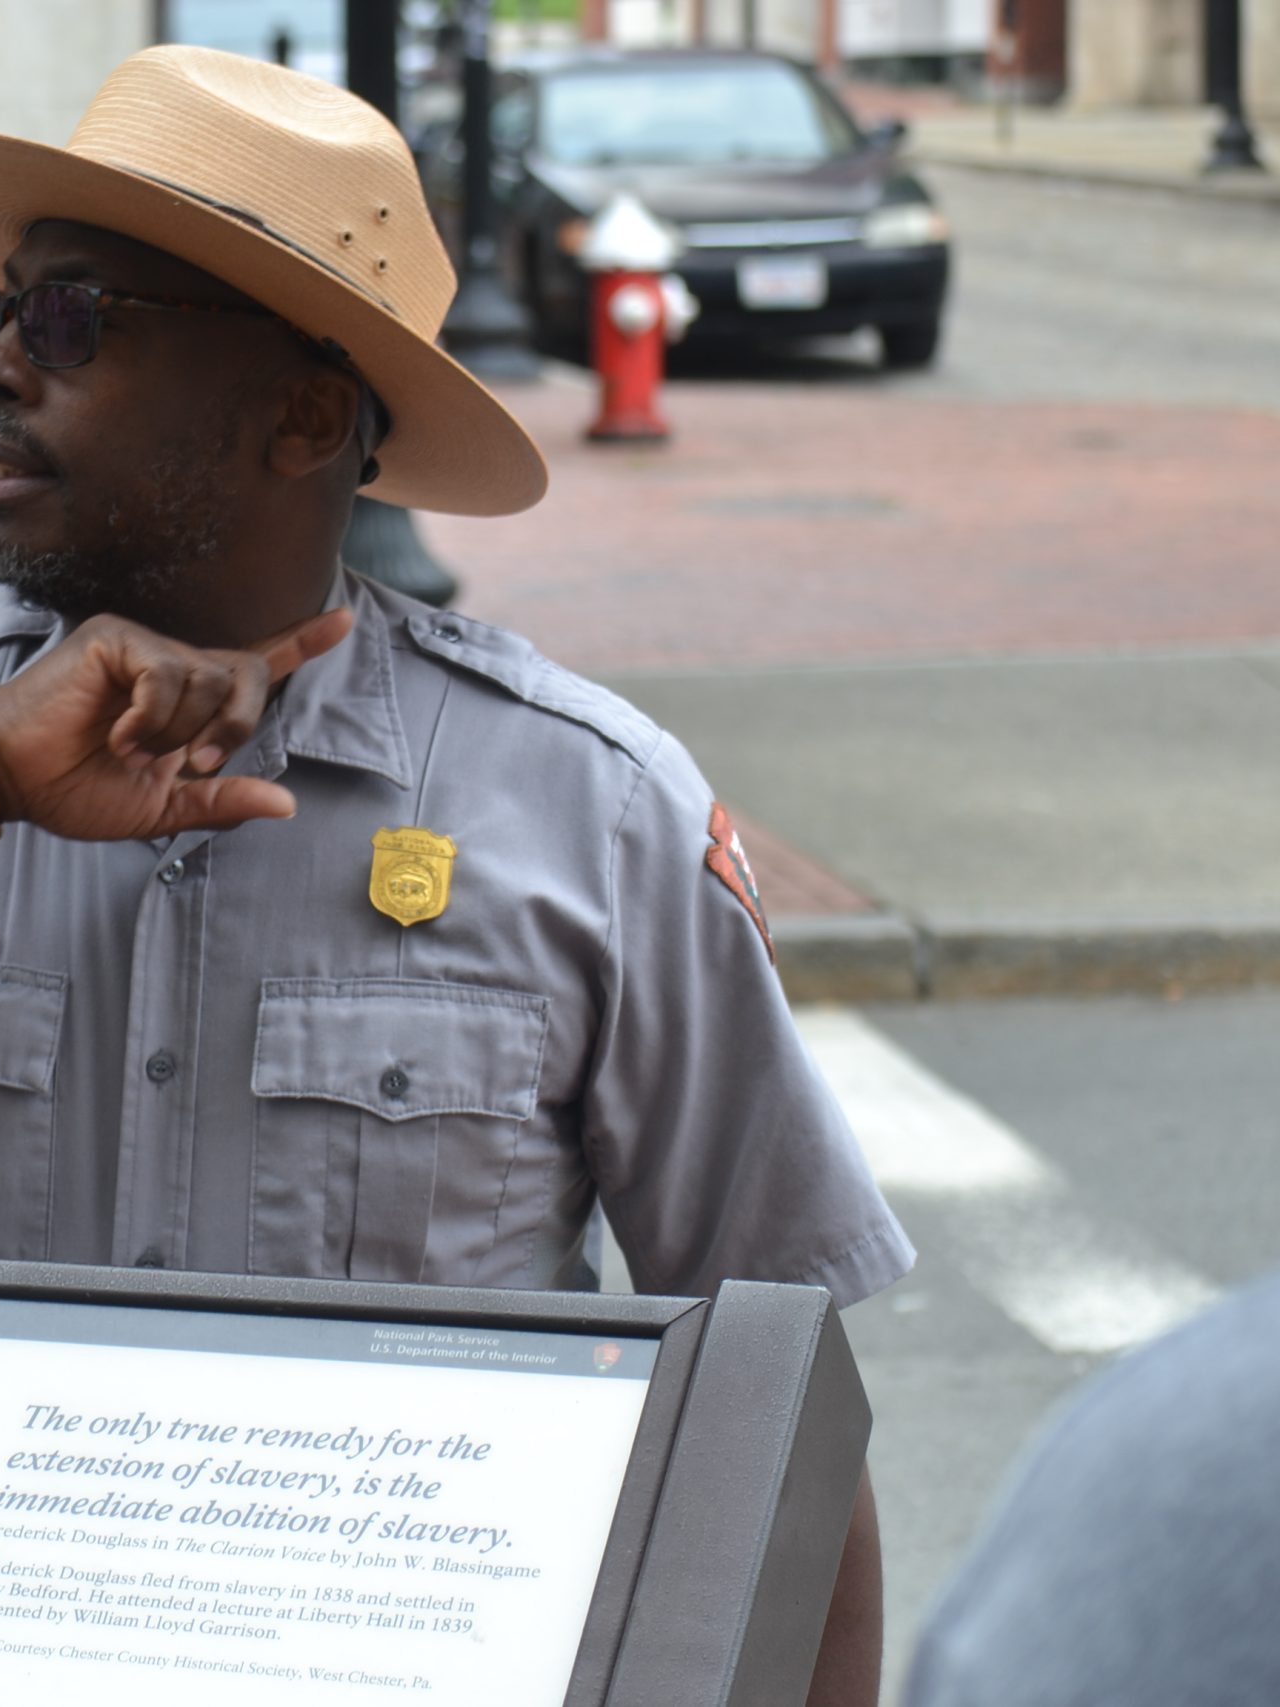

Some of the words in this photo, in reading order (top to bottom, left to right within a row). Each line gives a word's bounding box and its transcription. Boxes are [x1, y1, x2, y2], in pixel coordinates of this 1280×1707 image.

[370, 1344, 392, 1354] U.S.
[397, 1344, 467, 1359] Department
[473, 1349, 485, 1360] of
[488, 1351, 508, 1362] the
[512, 1353, 558, 1365] Interior
[374, 1329, 425, 1342] National
[427, 1332, 453, 1343] Park
[458, 1334, 500, 1346] Service
[23, 1405, 82, 1432] The
[89, 1412, 162, 1445] only
[167, 1418, 238, 1443] true
[244, 1426, 374, 1460] remedy
[369, 1429, 432, 1462] for
[437, 1434, 491, 1461] the
[7, 1450, 165, 1479] extension
[172, 1457, 213, 1489] of
[210, 1460, 341, 1499] slavery,
[353, 1469, 382, 1495] is
[388, 1472, 442, 1500] the
[179, 1499, 331, 1534] abolition
[339, 1511, 381, 1544] of
[377, 1514, 512, 1554] slavery.
[70, 1529, 148, 1550] Douglass
[152, 1536, 168, 1550] in
[176, 1537, 206, 1553] The
[210, 1541, 275, 1558] Clarion
[282, 1545, 326, 1562] Voice
[330, 1549, 351, 1568] by
[352, 1552, 397, 1568] John
[404, 1555, 425, 1570] W.
[432, 1557, 541, 1580] Blassingame
[8, 1582, 82, 1602] Bedford.
[88, 1589, 114, 1604] He
[117, 1594, 195, 1611] attended
[198, 1602, 207, 1612] a
[212, 1599, 272, 1618] lecture
[276, 1608, 294, 1619] at
[297, 1606, 362, 1627] Liberty
[366, 1612, 405, 1629] Hall
[408, 1616, 425, 1630] in
[432, 1617, 473, 1633] 1839
[59, 1566, 136, 1587] Douglass
[140, 1572, 175, 1589] fled
[178, 1575, 220, 1592] from
[224, 1580, 286, 1600] slavery
[290, 1584, 307, 1599] in
[313, 1587, 354, 1603] 1838
[357, 1592, 391, 1606] and
[394, 1595, 454, 1611] settled
[458, 1598, 474, 1612] in
[46, 1605, 68, 1625] by
[74, 1609, 139, 1628] William
[144, 1615, 195, 1635] Lloyd
[200, 1619, 280, 1641] Garrison.
[59, 1646, 114, 1661] Chester
[117, 1651, 170, 1669] County
[174, 1656, 244, 1673] Historical
[247, 1662, 302, 1680] Society,
[309, 1667, 344, 1682] West
[348, 1671, 406, 1689] Chester,
[411, 1676, 432, 1689] Pa.
